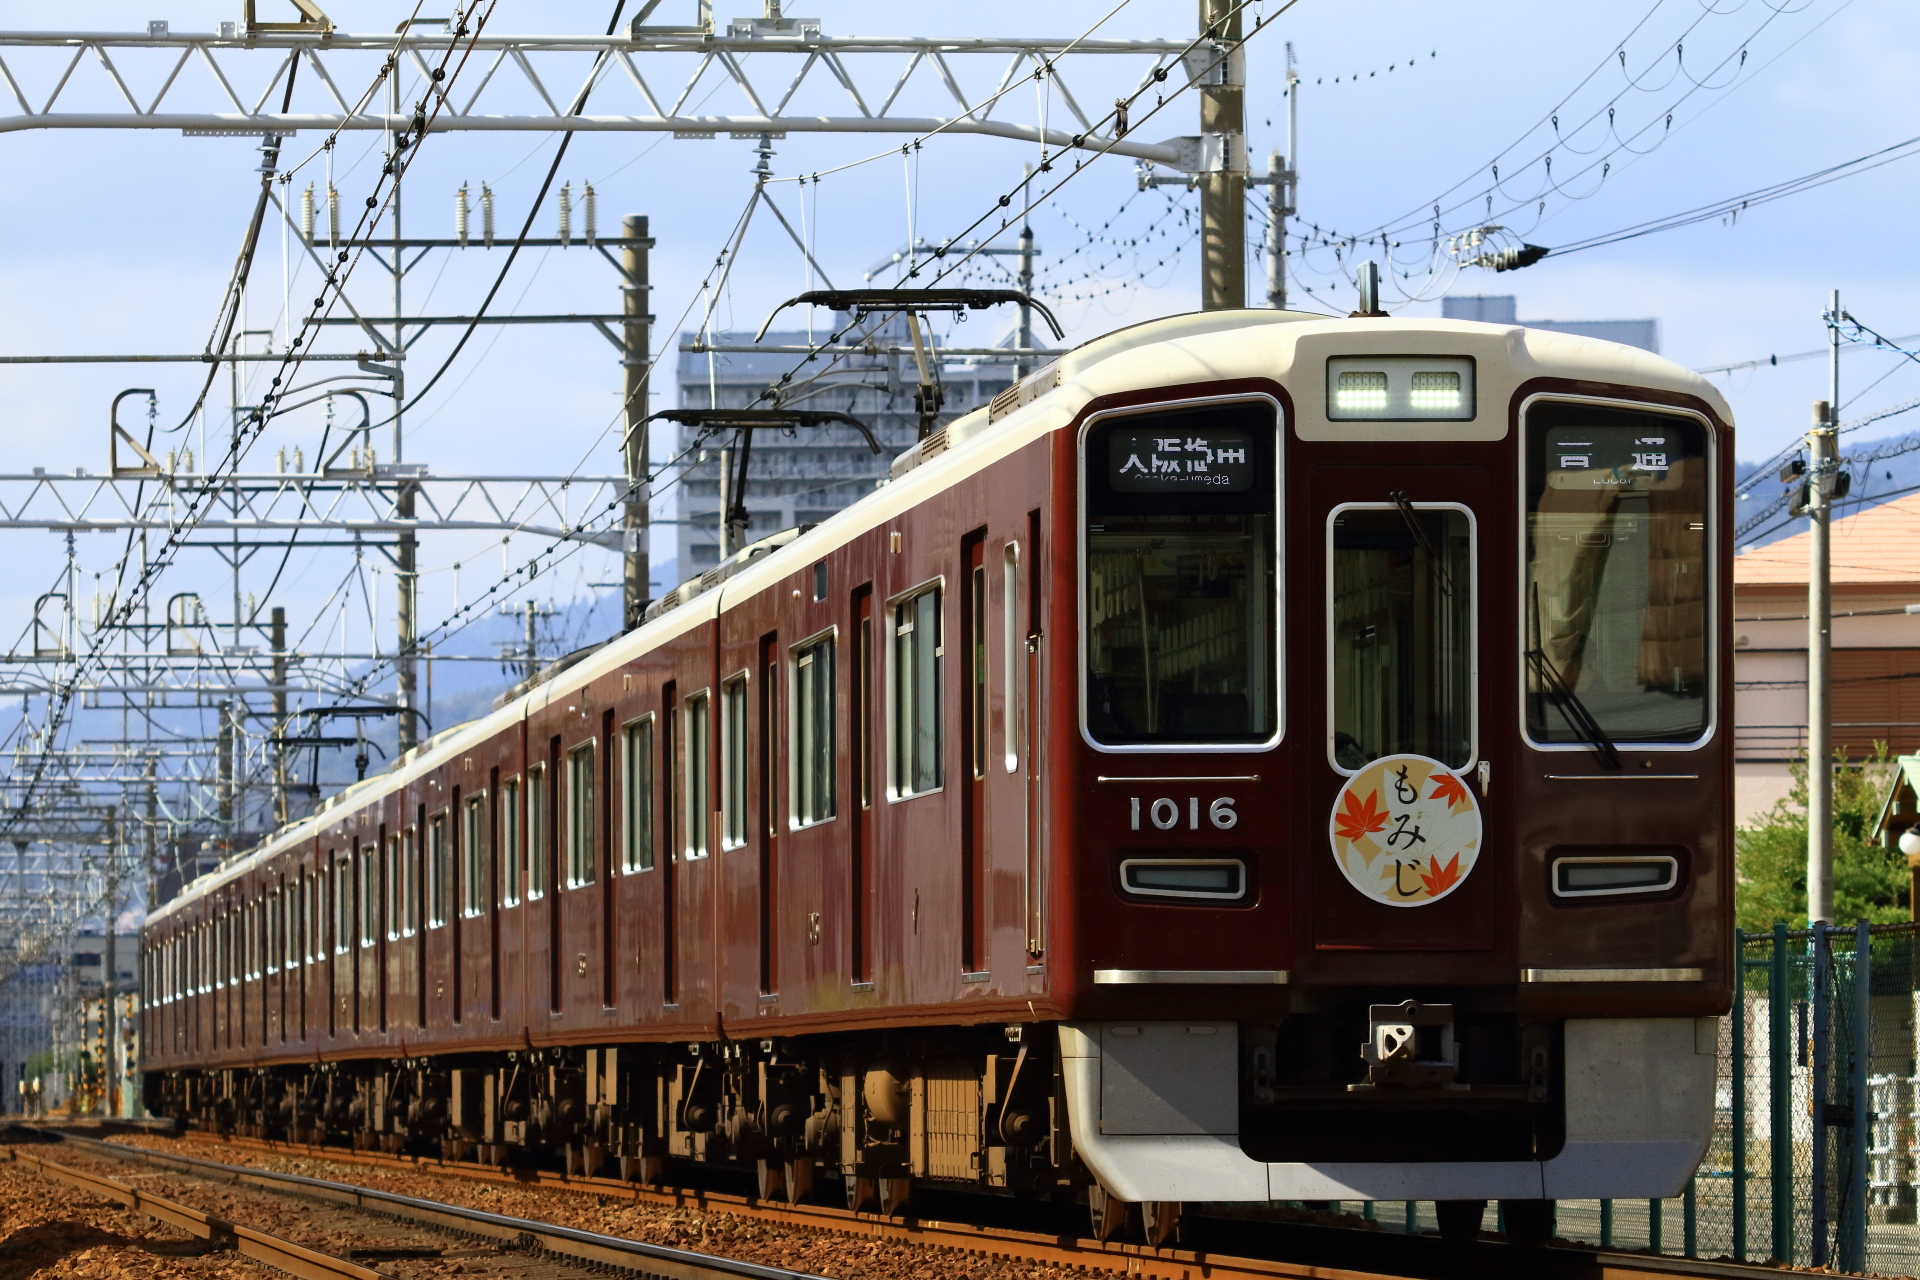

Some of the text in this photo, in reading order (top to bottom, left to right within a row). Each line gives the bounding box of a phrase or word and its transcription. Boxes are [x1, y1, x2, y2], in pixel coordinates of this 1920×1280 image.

[1130, 796, 1238, 831] 1016
[1387, 764, 1427, 897] もみじ
